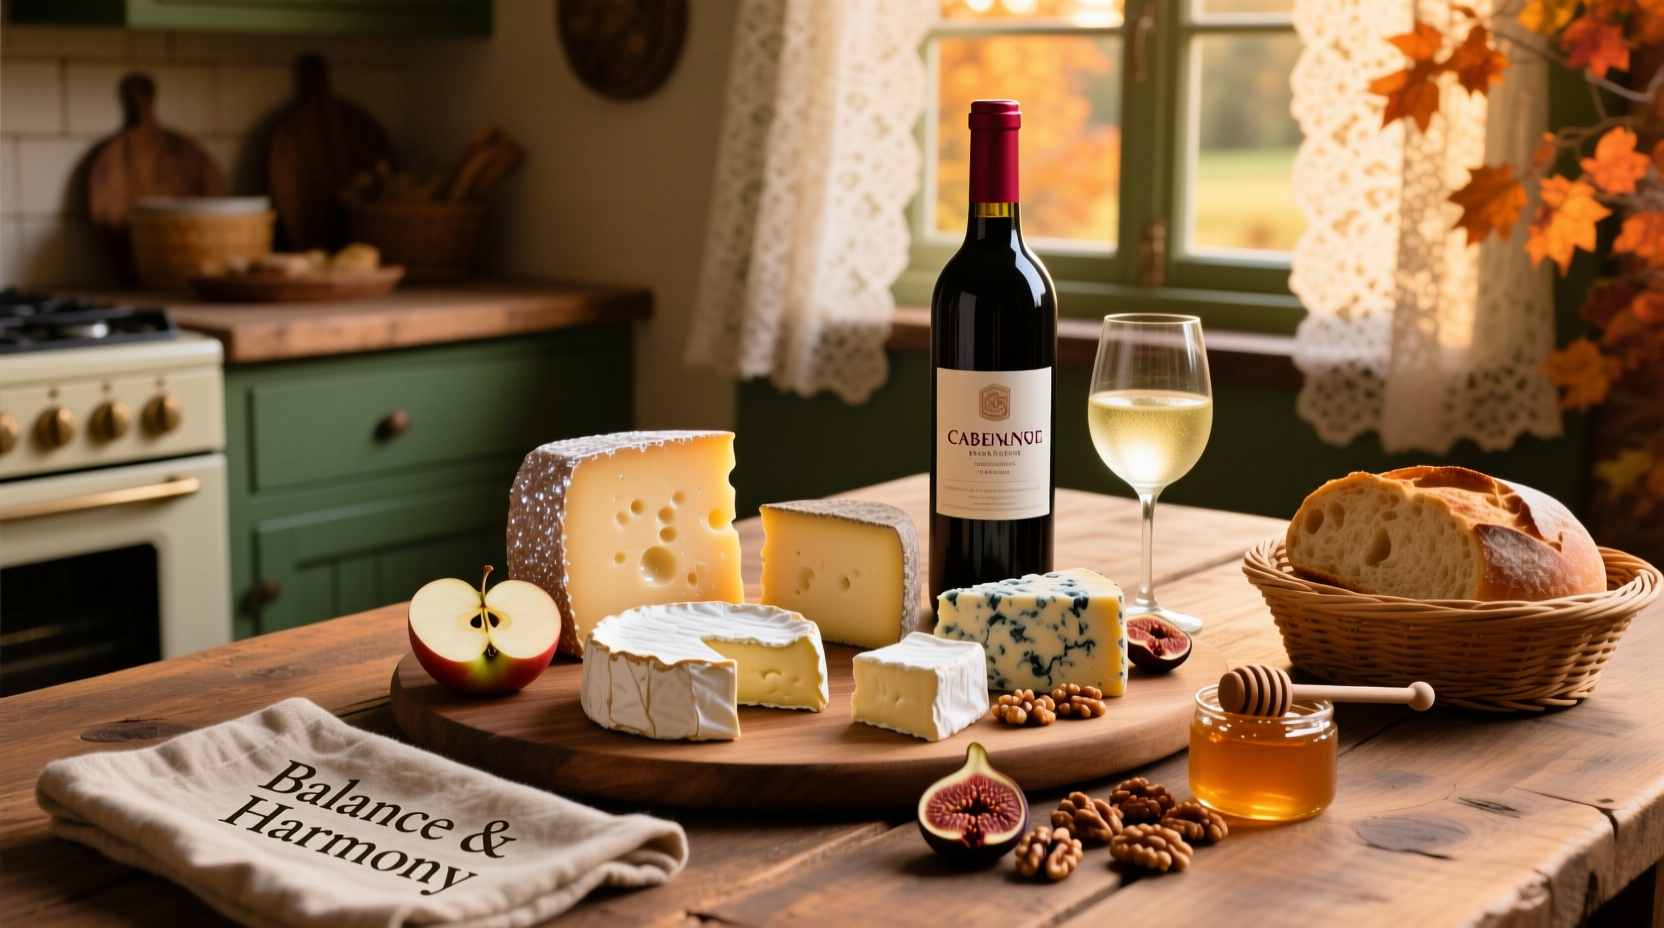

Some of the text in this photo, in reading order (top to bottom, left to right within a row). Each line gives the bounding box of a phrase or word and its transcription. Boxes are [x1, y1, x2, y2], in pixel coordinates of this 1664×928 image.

[217, 794, 479, 896] Harmony
[257, 759, 518, 859] Balance &
